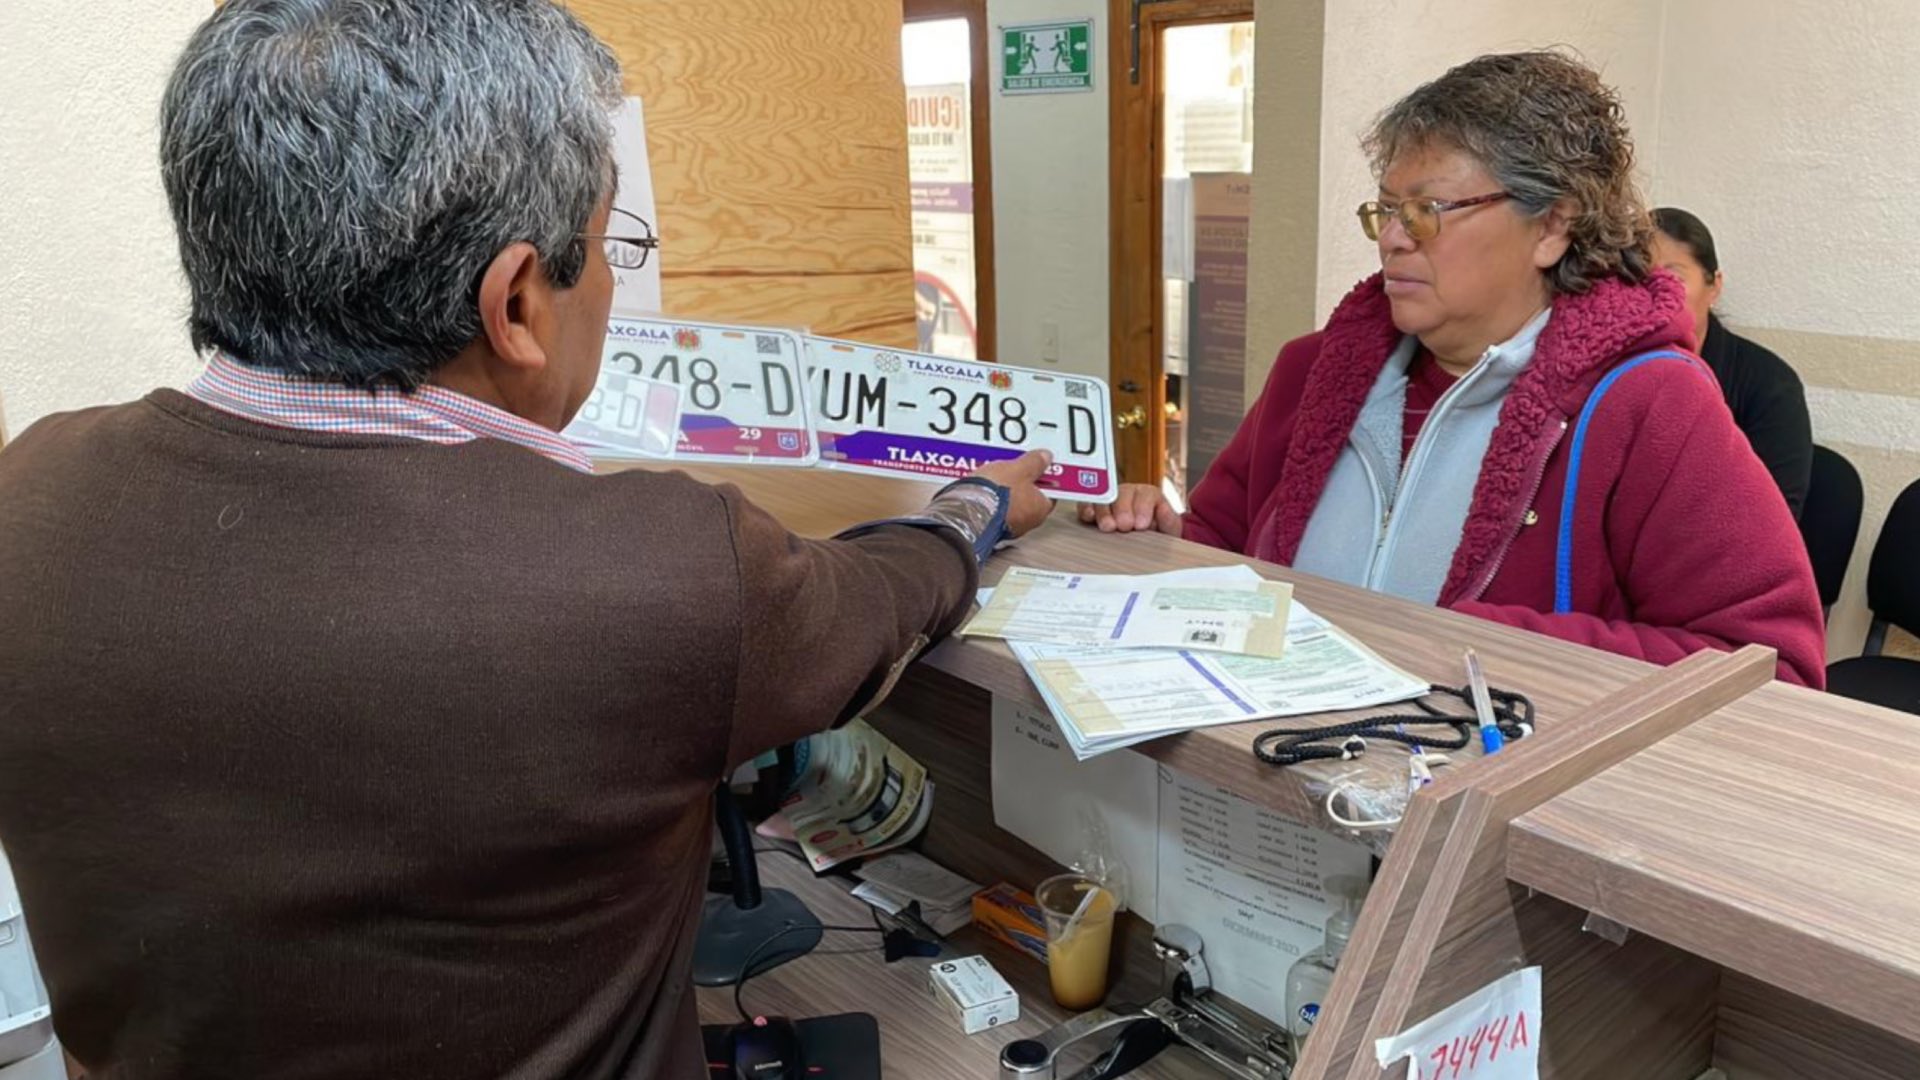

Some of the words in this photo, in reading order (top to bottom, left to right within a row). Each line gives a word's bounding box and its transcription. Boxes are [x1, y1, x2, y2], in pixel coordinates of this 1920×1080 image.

[907, 359, 984, 380] TLAXCALA
[808, 366, 1096, 455] UM-348-D
[738, 427, 761, 440] 29
[887, 446, 989, 471] TLAXCAL
